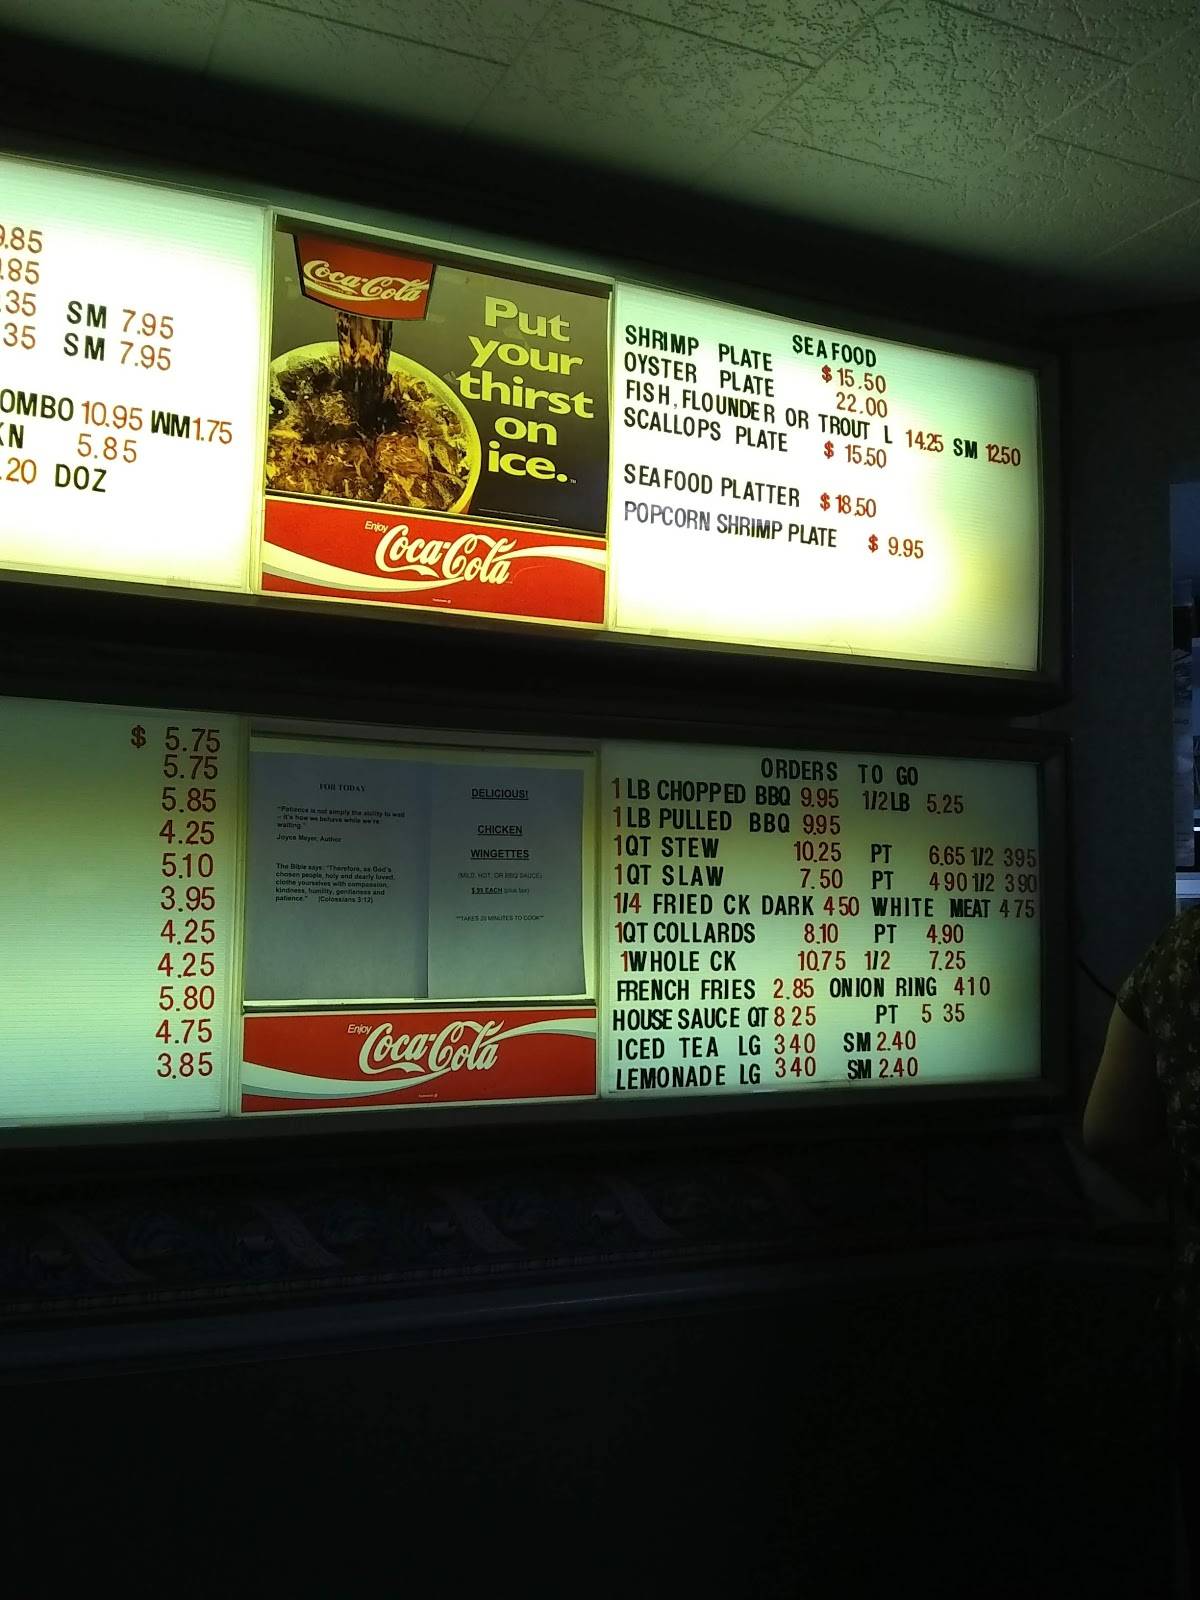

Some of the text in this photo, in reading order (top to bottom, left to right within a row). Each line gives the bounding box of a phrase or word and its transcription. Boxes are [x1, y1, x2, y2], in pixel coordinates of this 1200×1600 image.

[303, 260, 429, 302] Coca-Cola
[67, 300, 106, 329] SM
[122, 309, 174, 339] 7.95
[484, 295, 570, 342] Put
[63, 332, 105, 361] SM
[120, 341, 171, 371] 7.95
[467, 335, 583, 376] your
[625, 324, 699, 356] SHRIMP
[718, 343, 773, 372] PLATE
[792, 334, 876, 367] SEAFOOD
[455, 370, 595, 419] thirst
[624, 352, 888, 418] OYSTER PLATE 22.00
[82, 401, 143, 431] 10.95
[494, 416, 558, 446] on
[624, 407, 721, 441] SCALLOPS
[736, 426, 788, 452] PLATE
[77, 433, 137, 463] 5.85
[786, 408, 809, 429] OR
[818, 414, 870, 440] TROUT
[884, 425, 893, 444] L
[906, 429, 944, 452] 14.25
[953, 438, 978, 459] SM
[487, 441, 568, 483] ice.
[55, 463, 106, 493] DOZ
[624, 463, 713, 495] SEAFOOD
[721, 477, 800, 507] PLATTER
[624, 501, 710, 531] POPCORN
[717, 513, 783, 540] SHRIMP
[788, 524, 837, 548] PLATE
[365, 520, 517, 586] Enjoy Coca-Cola
[131, 724, 221, 753] $ 5.75
[163, 754, 218, 780] 5.75
[761, 758, 918, 785] ORDERS TO GO
[162, 787, 217, 813] 5.85
[471, 788, 528, 800] DELICIOUS!
[657, 779, 746, 804] CHOPPED
[755, 786, 790, 806] BBQ
[801, 787, 839, 808] 9.95
[927, 794, 964, 814] 5.25
[159, 819, 215, 844] 4.25
[477, 824, 523, 835] CHICKEN
[659, 808, 732, 831] PULLED
[750, 813, 790, 833] BBQ
[803, 814, 840, 835] 9.95
[162, 852, 214, 879] 5.10
[470, 848, 530, 860] WINGETTES
[661, 836, 719, 858] STEW
[794, 841, 841, 863] 10.25
[871, 844, 892, 863] PT
[929, 845, 965, 866] 6.65
[971, 847, 994, 866] 1/2
[662, 865, 724, 886] SLAW
[800, 869, 843, 890] 7.50
[872, 871, 893, 890] PT
[972, 873, 994, 892] 1/2
[160, 885, 215, 912] 3.95
[614, 892, 641, 914] 1/4
[653, 893, 712, 914] FRIED
[724, 894, 750, 915] CK
[762, 895, 814, 916] DARK
[872, 897, 934, 917] WHITE
[950, 898, 991, 918] MEAT
[160, 918, 215, 945] 4.25
[654, 922, 755, 943] COLLARDS
[804, 923, 839, 944] 8.10
[874, 924, 897, 943] PT
[927, 924, 964, 944] 4.90
[158, 952, 215, 978] 4.25
[710, 950, 736, 971] CK
[797, 950, 846, 972] 10.75
[864, 950, 890, 970] 1/2
[929, 951, 966, 971] 7.25
[159, 985, 215, 1012] 5.80
[617, 979, 689, 1001] FRENCH
[701, 979, 755, 1000] FRIES
[773, 978, 814, 1000] 2.85
[829, 977, 884, 998] ONION
[896, 976, 937, 996] RING
[156, 1019, 212, 1045] 4.75
[613, 1007, 672, 1031] HOUSE
[678, 1007, 740, 1029] SAUCE
[748, 1007, 769, 1027] QT
[875, 1005, 898, 1024] PT
[348, 1019, 504, 1075] Enjoy Coca-Cola
[617, 1038, 665, 1061] ICED
[679, 1036, 719, 1058] TEA
[738, 1035, 760, 1056] LG
[843, 1032, 871, 1052] SM
[876, 1030, 916, 1051] 2.40
[157, 1052, 213, 1079] 3.85
[616, 1065, 725, 1091] LEMONADE
[740, 1063, 760, 1084] LG
[848, 1059, 871, 1079] SM
[879, 1057, 918, 1079] 2.40
